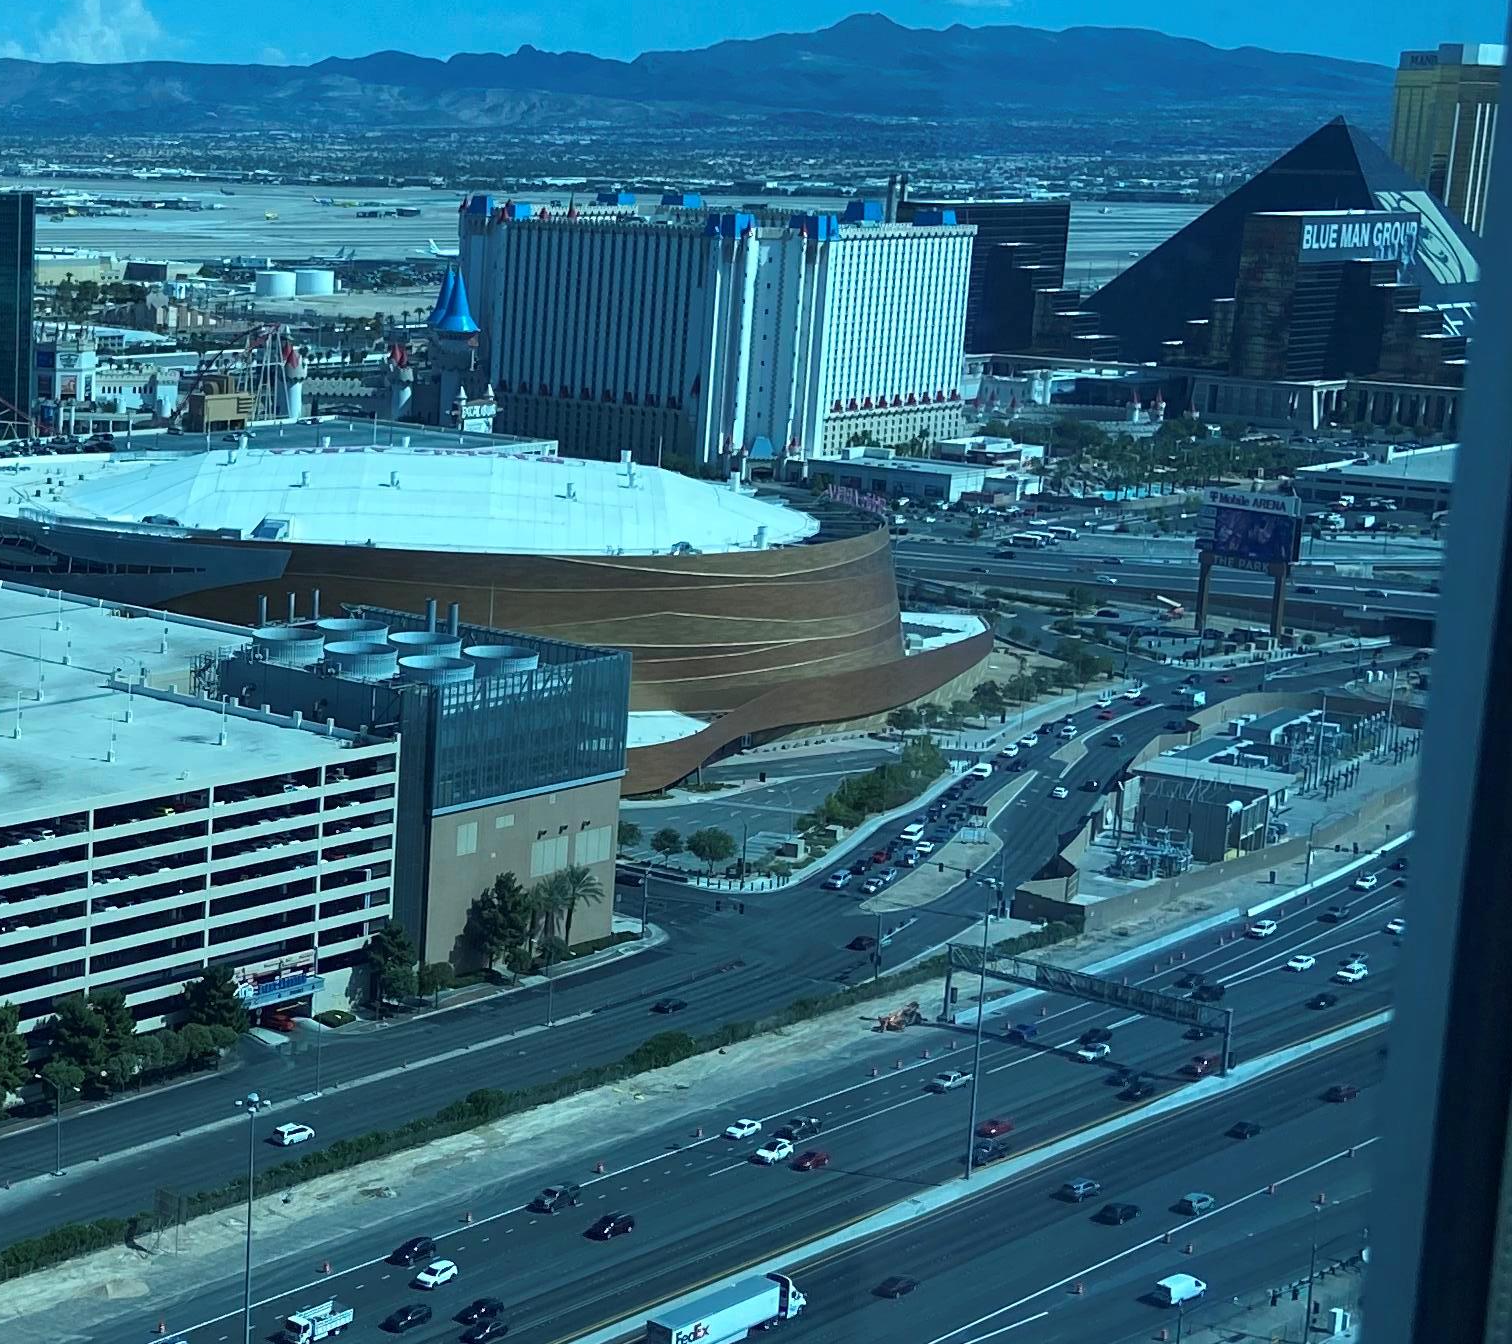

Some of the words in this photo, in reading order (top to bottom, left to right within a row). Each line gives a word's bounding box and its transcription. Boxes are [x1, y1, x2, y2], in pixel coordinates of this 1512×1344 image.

[1302, 224, 1339, 250] BLUE
[1340, 222, 1370, 248] MAN
[1372, 221, 1418, 247] GROUP
[1252, 497, 1286, 512] ARENA
[1214, 554, 1234, 567] THE
[1238, 558, 1270, 573] PARK
